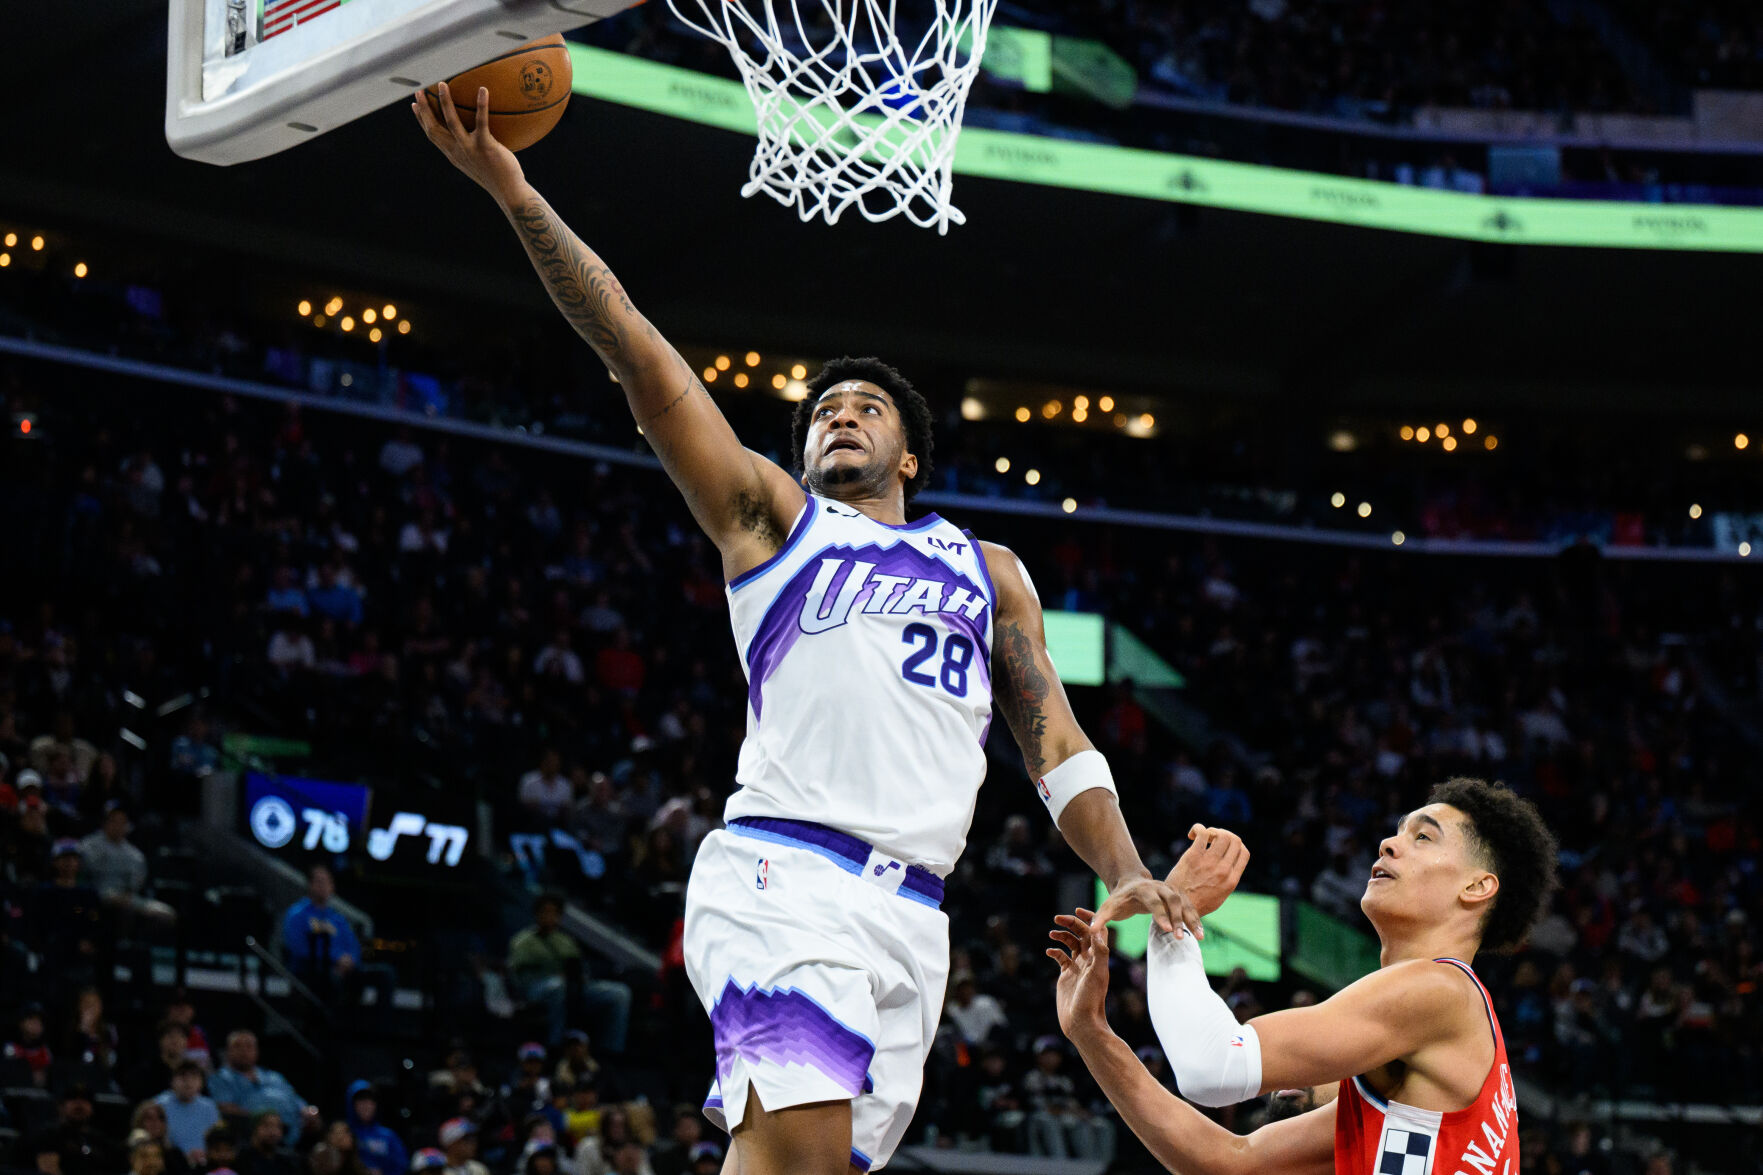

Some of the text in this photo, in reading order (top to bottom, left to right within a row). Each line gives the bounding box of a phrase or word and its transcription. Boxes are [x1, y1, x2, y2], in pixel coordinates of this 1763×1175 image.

[928, 537, 967, 556] LVT
[798, 558, 990, 635] UTAH
[902, 622, 974, 698] 28
[425, 821, 468, 866] 77
